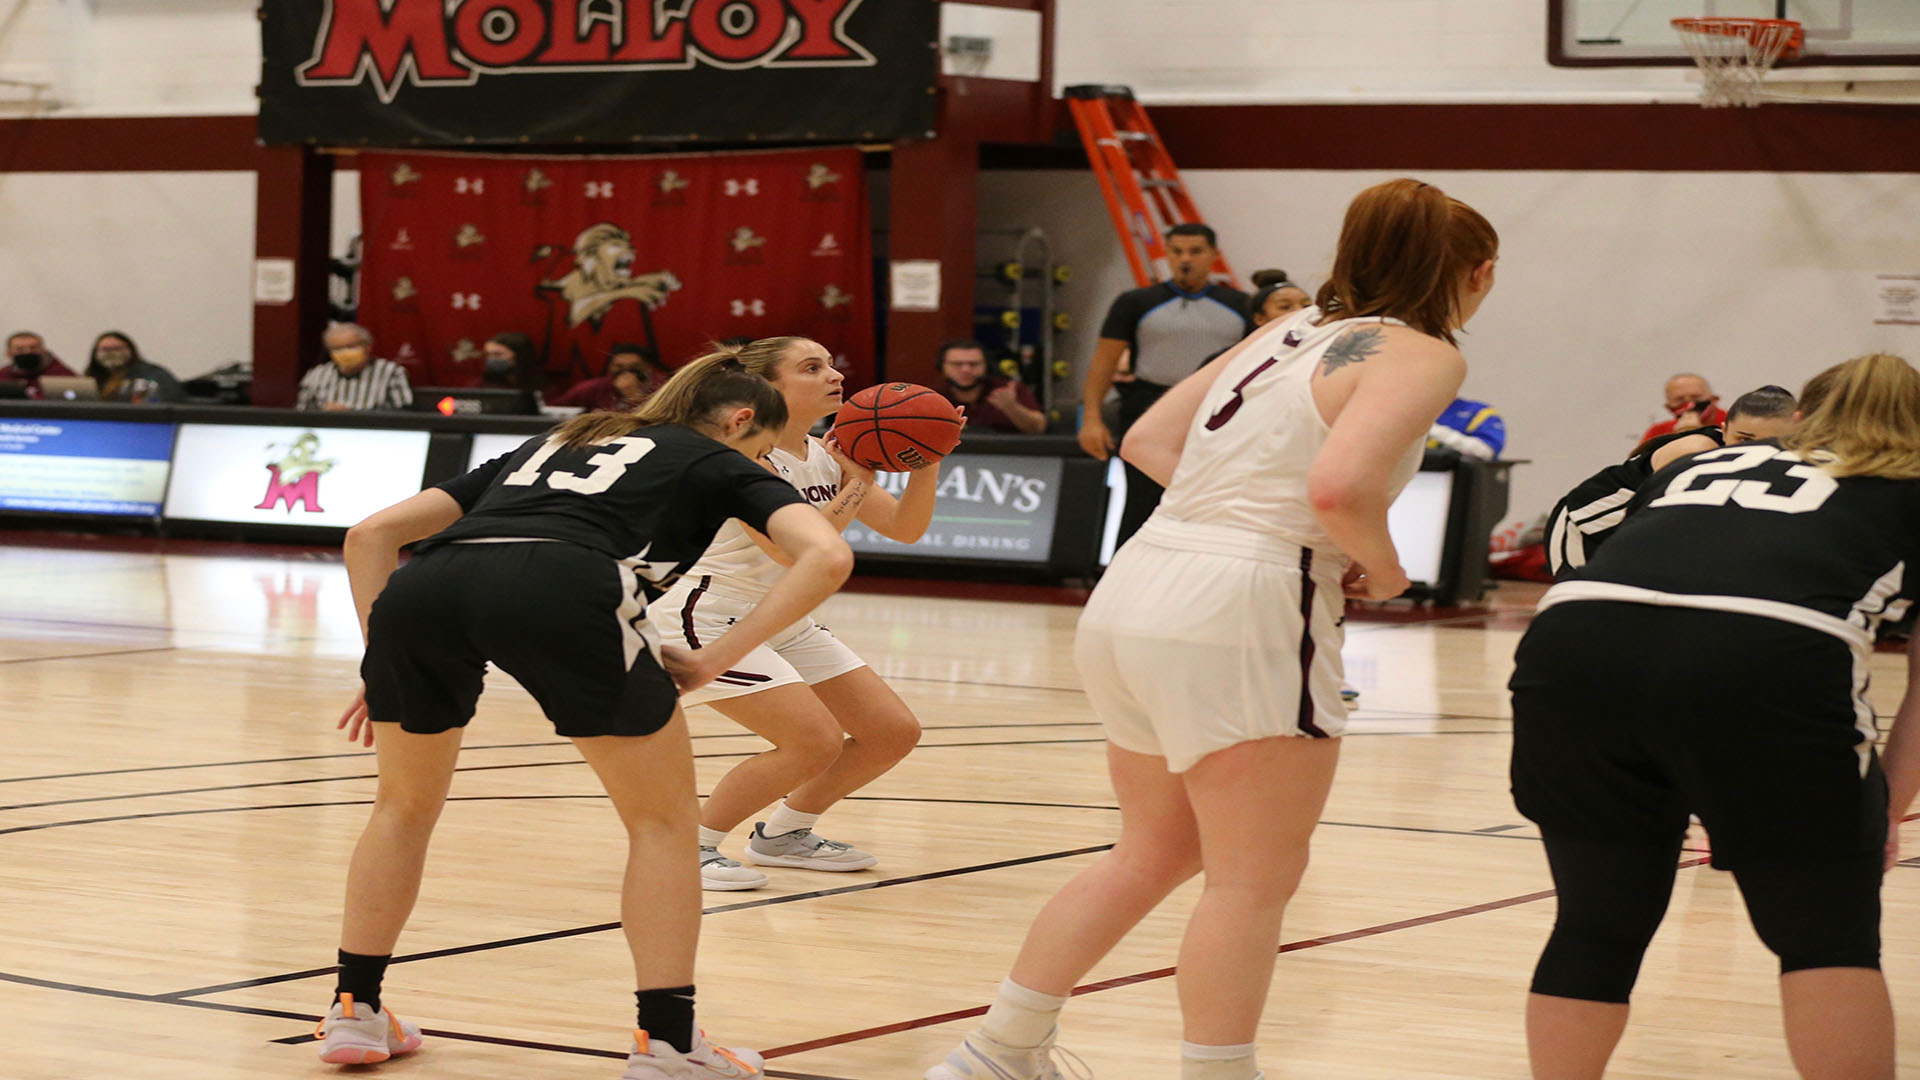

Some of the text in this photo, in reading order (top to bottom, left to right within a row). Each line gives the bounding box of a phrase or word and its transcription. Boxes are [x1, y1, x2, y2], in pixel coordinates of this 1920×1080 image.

[296, 0, 877, 103] MOLLOY
[503, 432, 656, 495] 13
[1648, 445, 1840, 514] 23
[952, 533, 1031, 551] DINING
